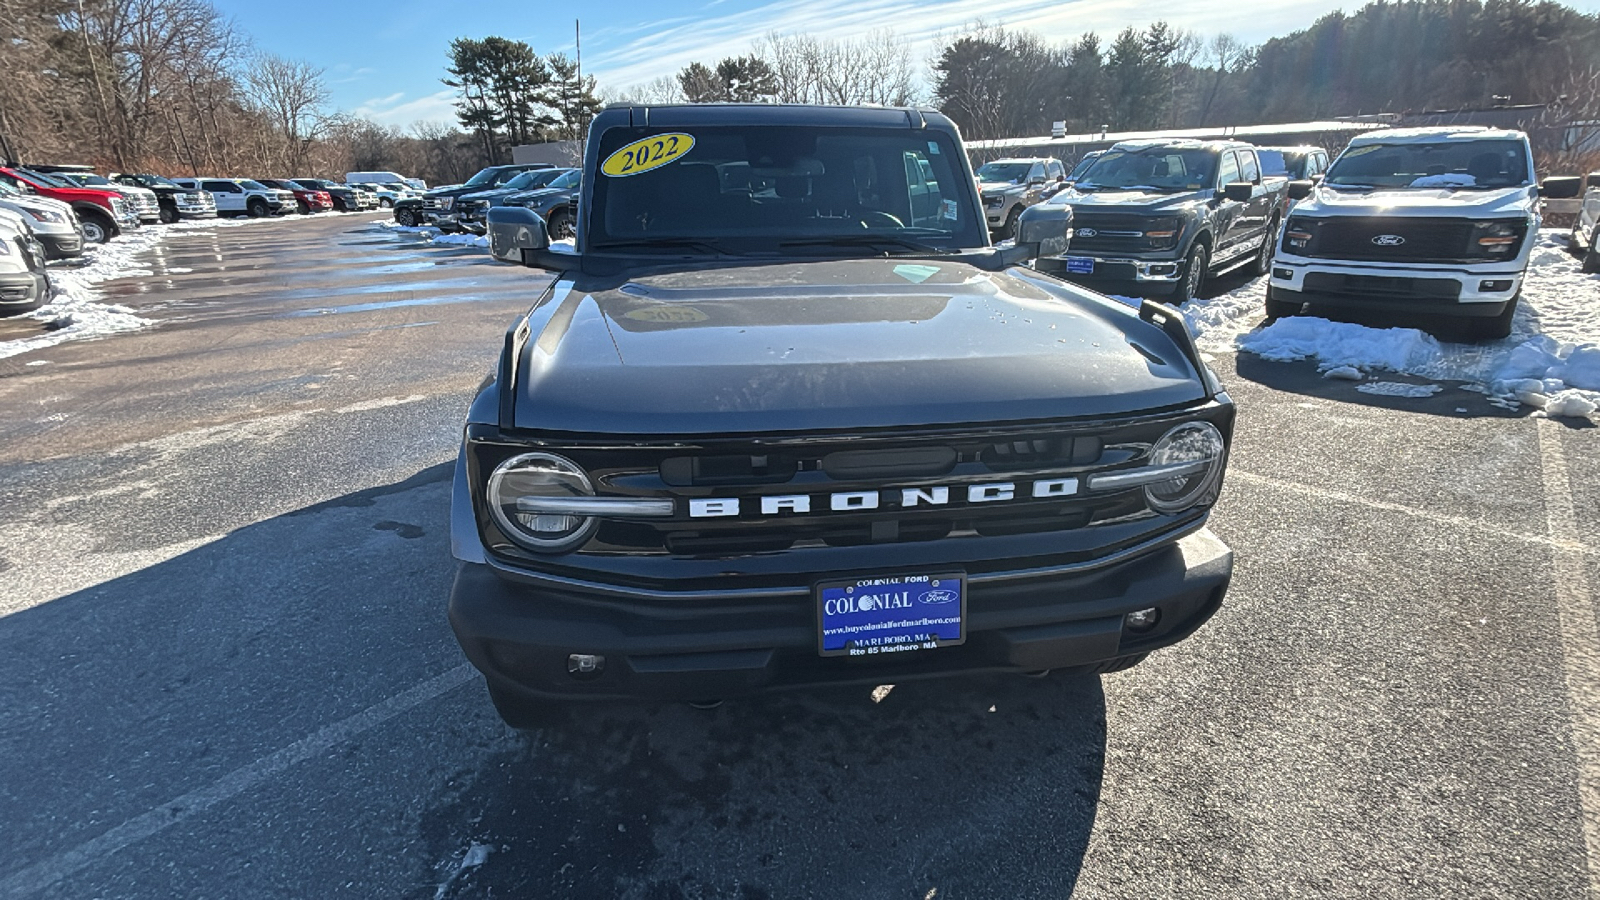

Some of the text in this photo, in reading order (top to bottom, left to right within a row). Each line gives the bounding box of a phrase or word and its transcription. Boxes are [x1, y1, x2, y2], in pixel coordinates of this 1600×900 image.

[621, 136, 679, 172] 2022
[1377, 235, 1399, 244] Ford
[689, 477, 1079, 518] BRONCO
[904, 575, 929, 583] FORD
[926, 591, 950, 602] Ford
[824, 591, 912, 615] COLONIAL
[823, 617, 961, 636] www.buycolonialfordmarlboro.com
[914, 633, 931, 642] MA
[850, 648, 865, 656] Rte
[867, 646, 879, 654] 85
[880, 644, 919, 653] Marlboro
